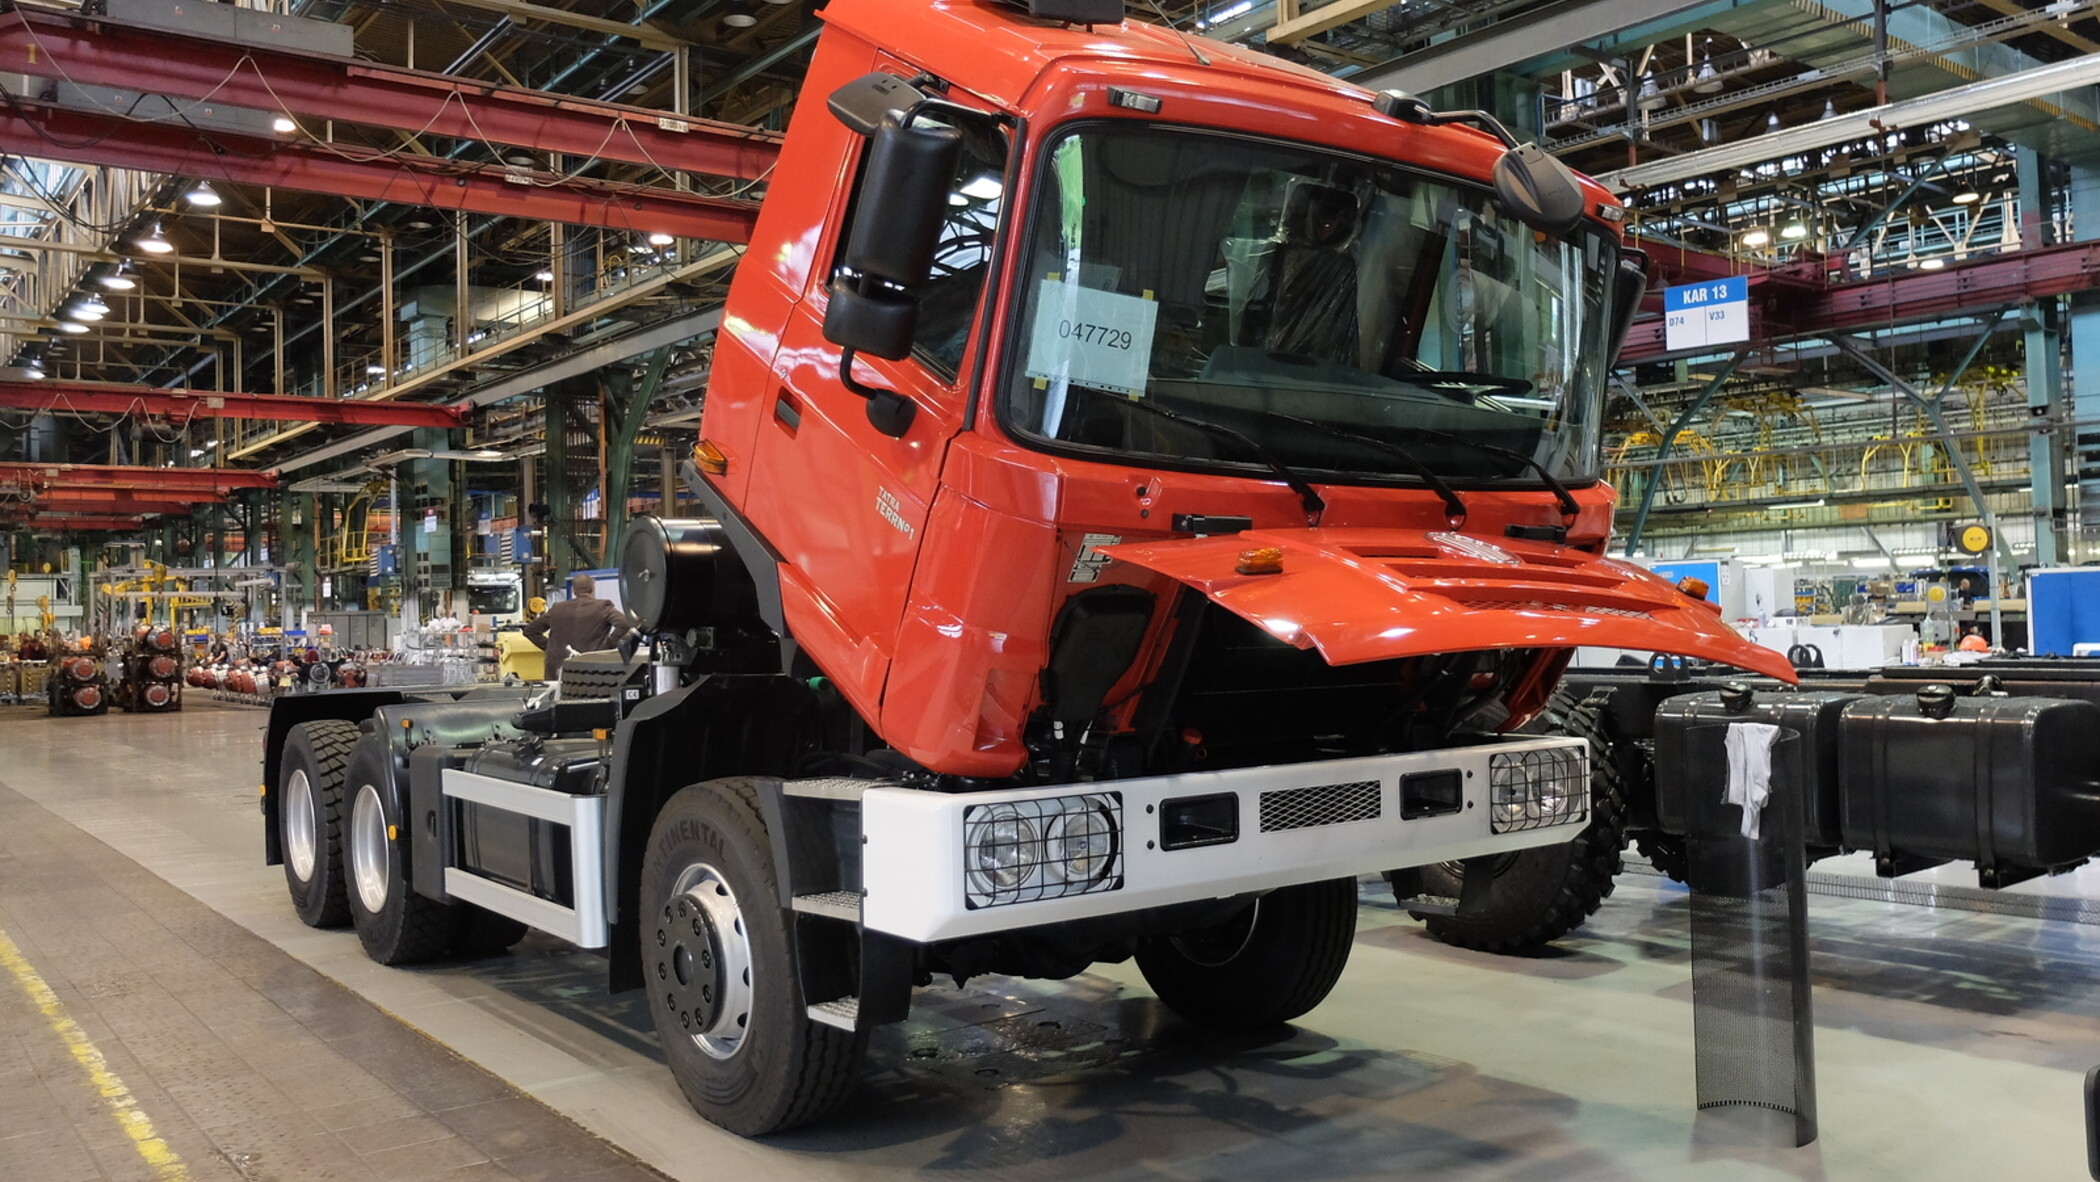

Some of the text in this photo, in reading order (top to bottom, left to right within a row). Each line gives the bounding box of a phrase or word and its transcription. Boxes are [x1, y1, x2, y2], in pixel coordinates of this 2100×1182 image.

[1683, 284, 1727, 304] KAR 13
[1709, 310, 1725, 321] V33
[1059, 319, 1132, 350] 047729
[879, 485, 900, 512] TATRA
